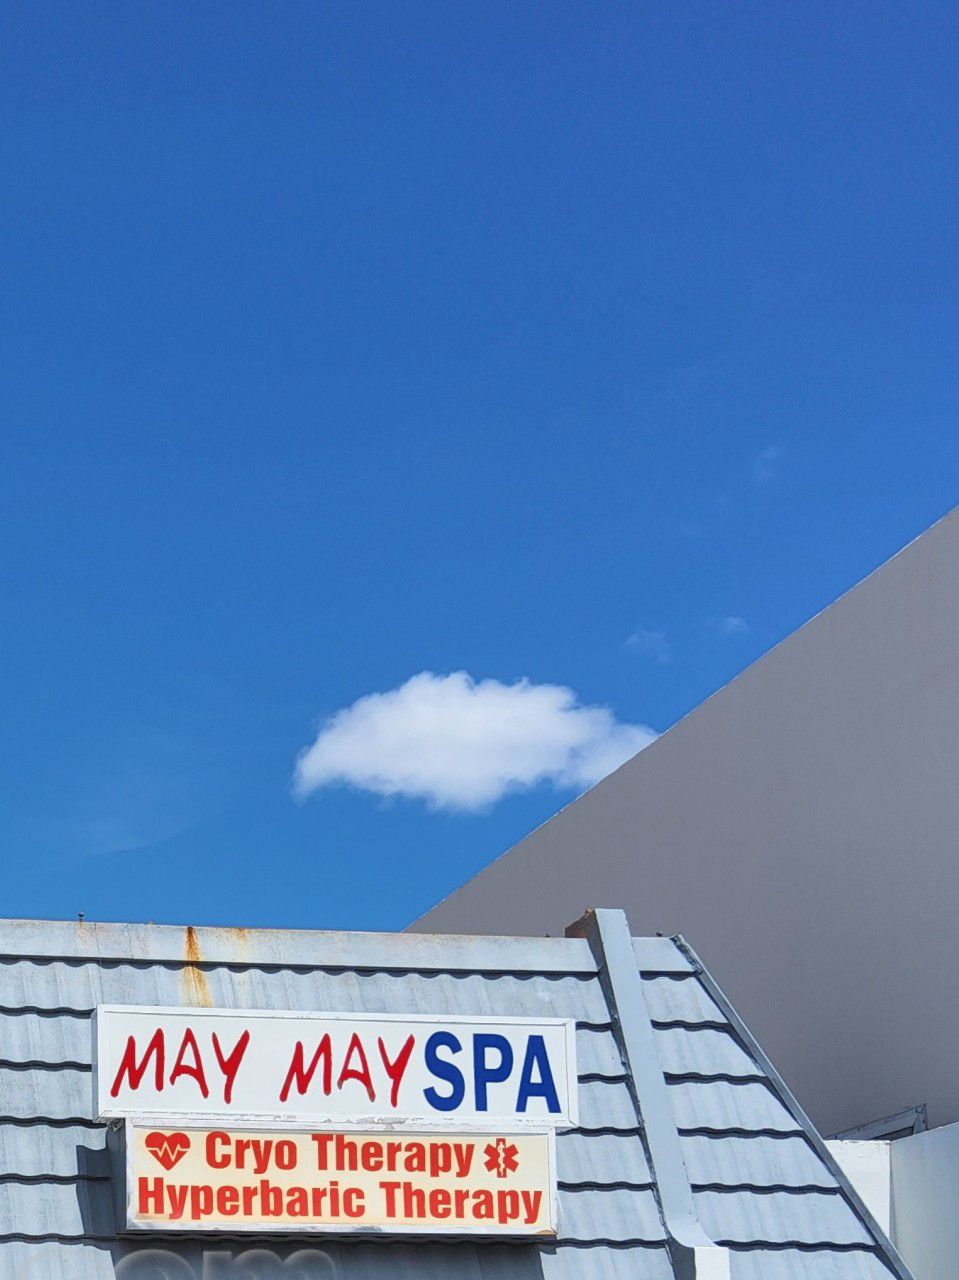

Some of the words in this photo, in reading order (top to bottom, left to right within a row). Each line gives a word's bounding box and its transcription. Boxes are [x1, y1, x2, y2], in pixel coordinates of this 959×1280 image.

[110, 1027, 250, 1104] MAY
[280, 1032, 414, 1108] MAY
[423, 1030, 562, 1114] SPA
[206, 1131, 301, 1174] Cryo
[312, 1133, 476, 1177] Therapy
[138, 1177, 366, 1220] Hyperbaric
[379, 1181, 543, 1224] Therapy
